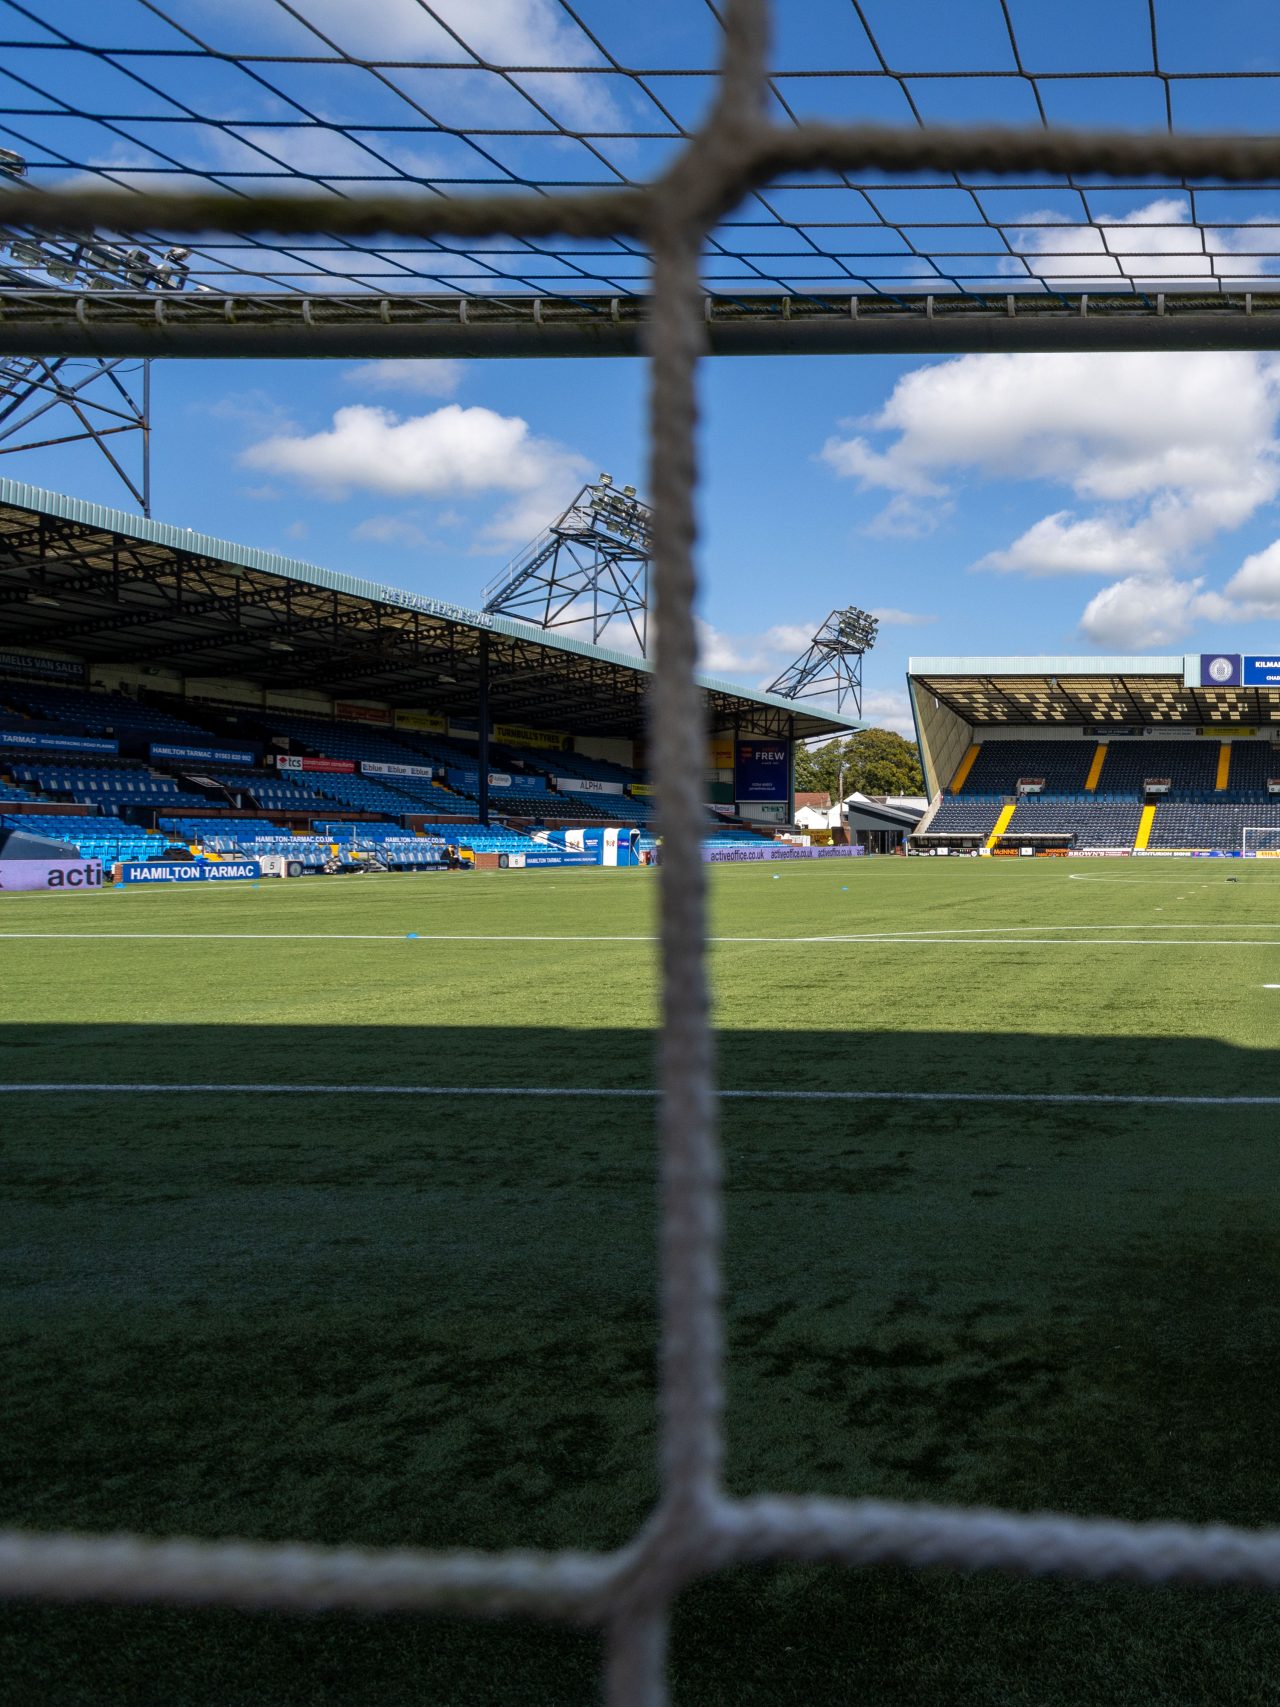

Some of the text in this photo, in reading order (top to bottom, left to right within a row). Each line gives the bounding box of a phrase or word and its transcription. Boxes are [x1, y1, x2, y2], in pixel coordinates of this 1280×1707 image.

[35, 659, 54, 671] VAN
[55, 662, 84, 675] SALES
[2, 735, 37, 744] TARMAC
[152, 747, 186, 756] HAMILTON
[187, 750, 212, 758] TARMAC
[755, 752, 785, 761] FREW
[288, 757, 301, 768] tcs
[580, 781, 603, 791] ALPHA
[255, 835, 334, 843] HAMILTON-TARMAC.CO.UK
[710, 850, 764, 862] activeoffice.co.uk
[771, 849, 812, 859] activeoffice.co.uk
[818, 848, 852, 858] activeoffice.co.uk
[269, 862, 275, 870] 5
[130, 865, 254, 880] HAMILTON TARMAC
